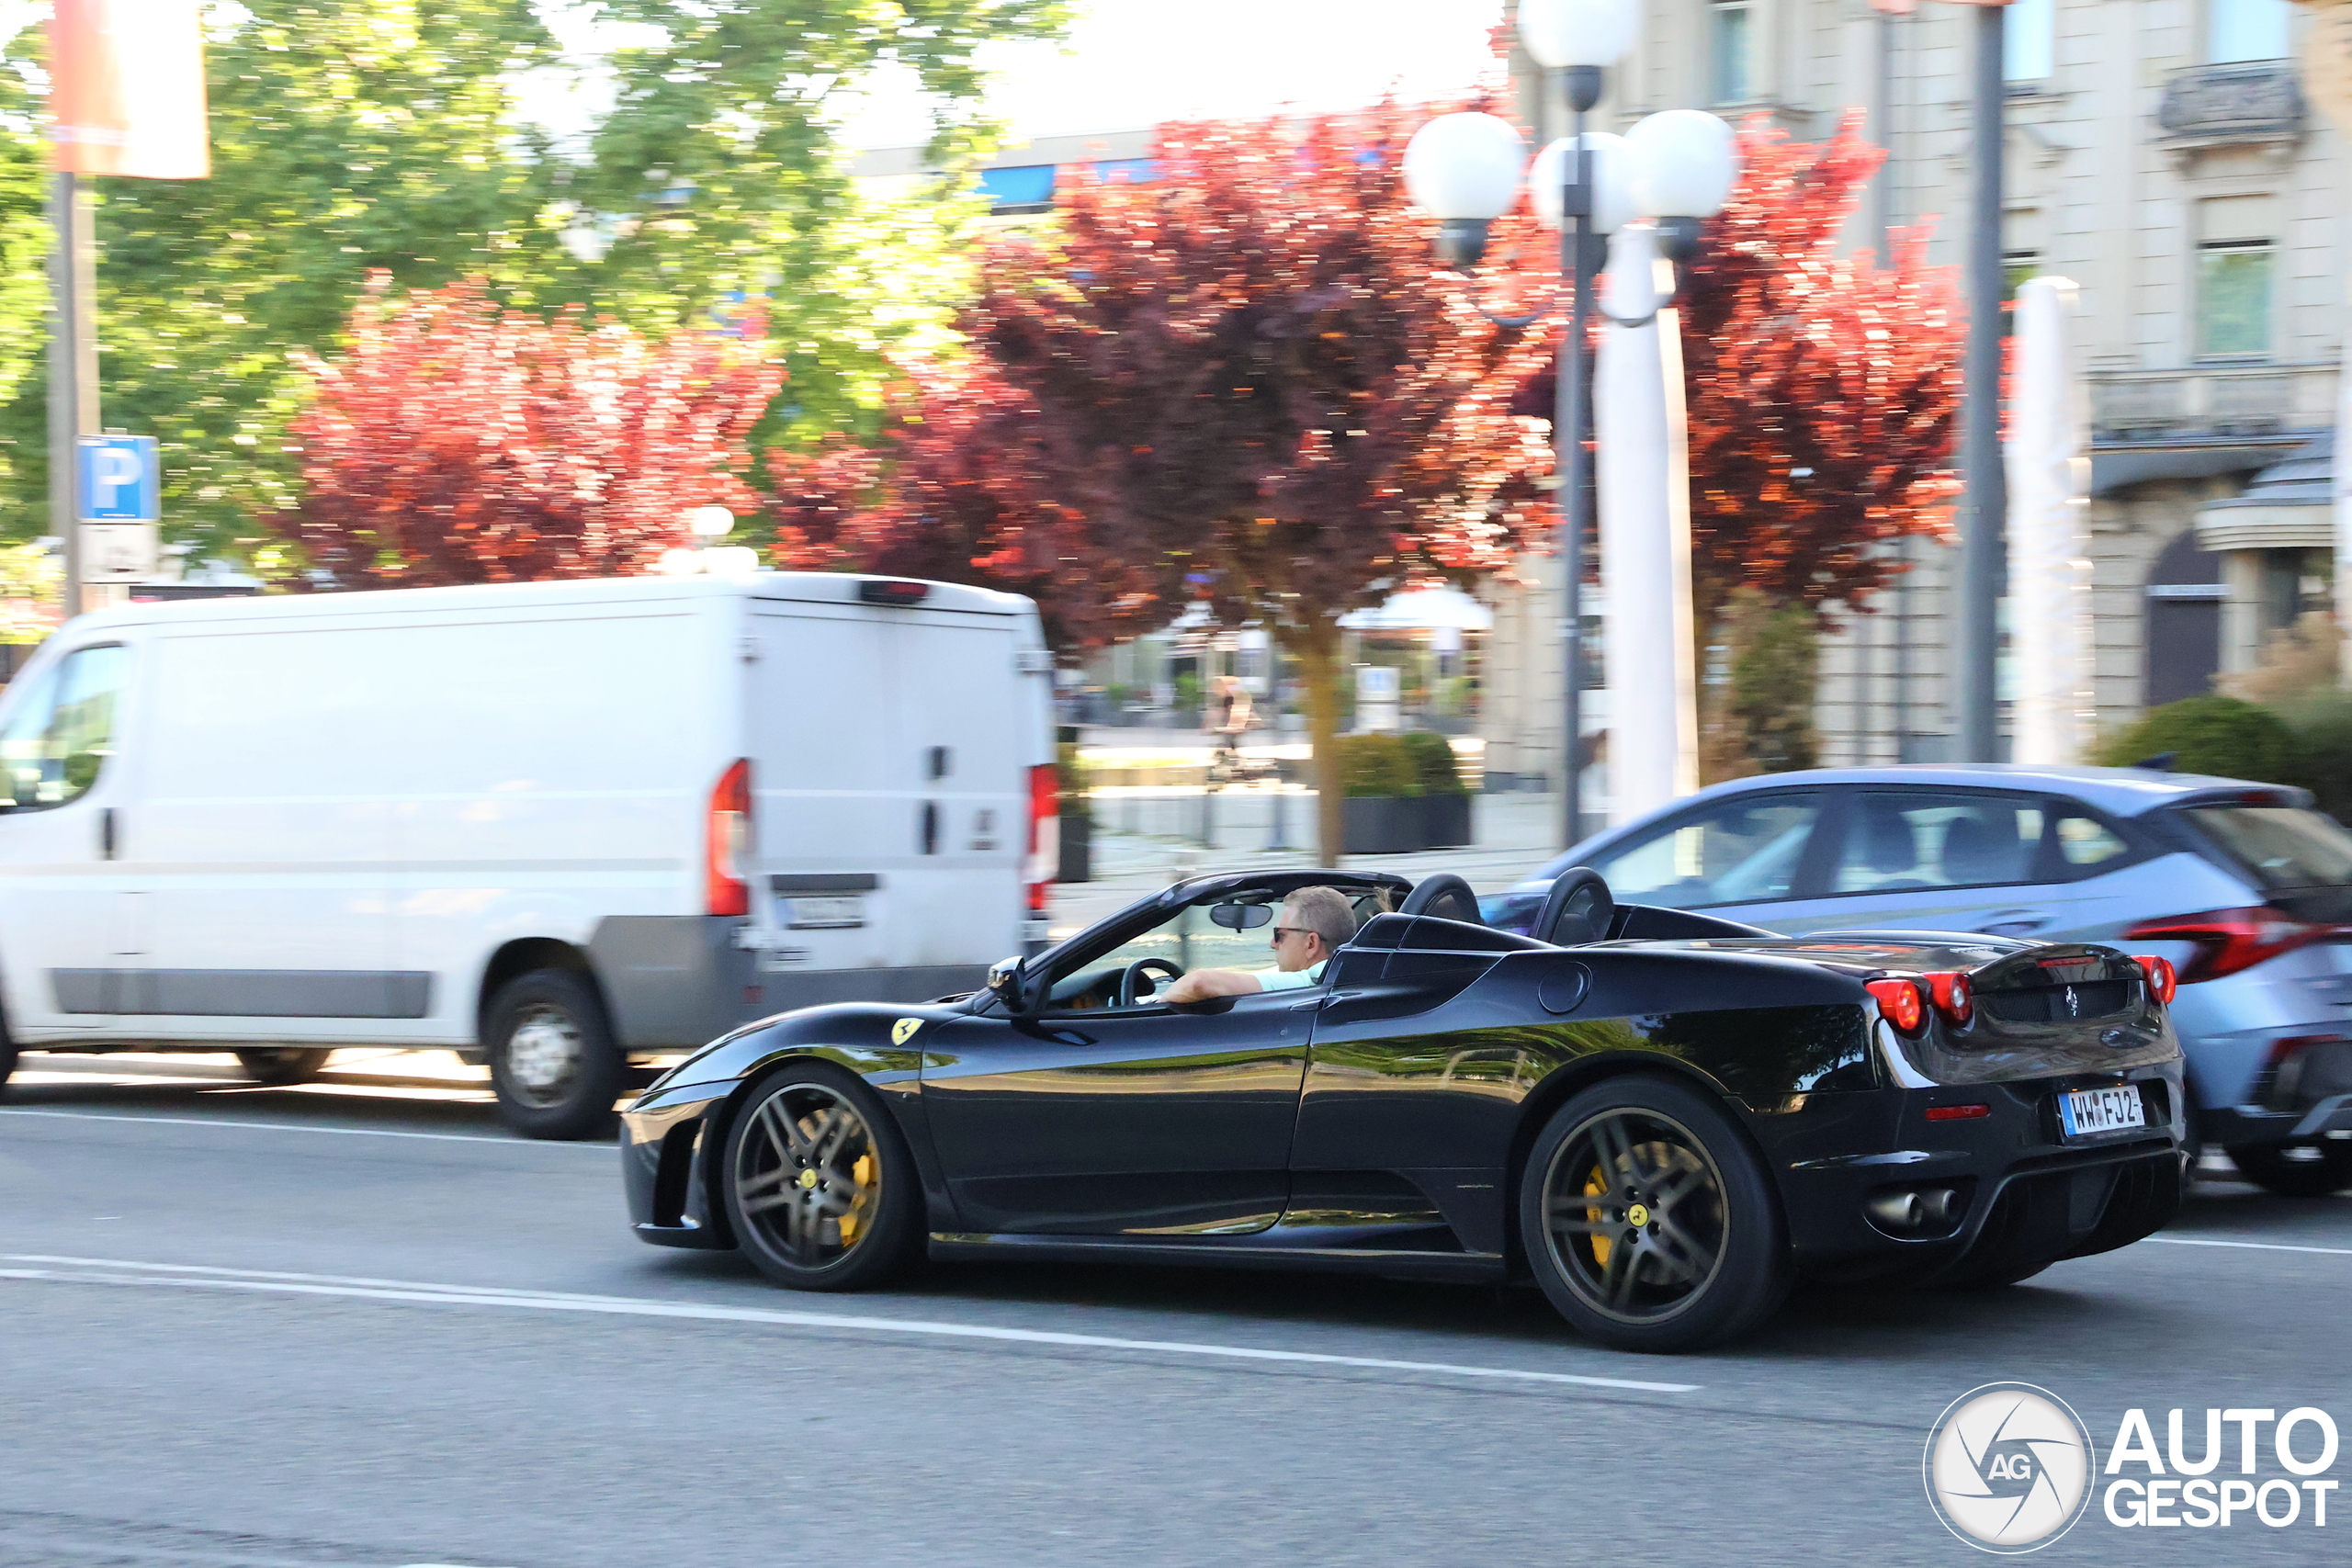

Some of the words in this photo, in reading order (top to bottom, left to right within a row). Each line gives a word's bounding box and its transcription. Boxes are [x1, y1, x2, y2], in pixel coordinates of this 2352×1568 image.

[92, 447, 142, 509] P
[2072, 1095, 2096, 1129] WW
[2102, 1090, 2135, 1125] FJ2
